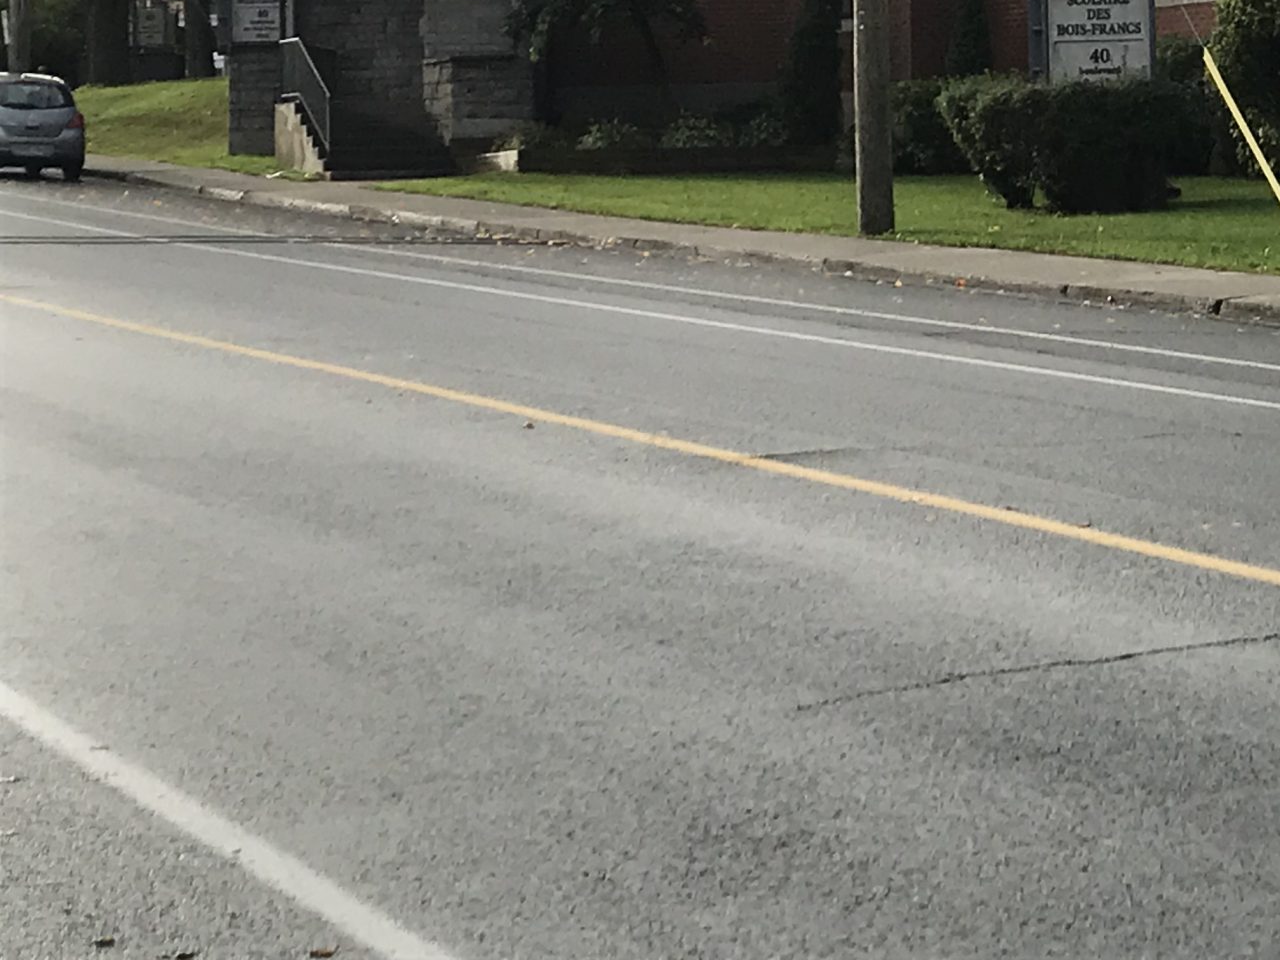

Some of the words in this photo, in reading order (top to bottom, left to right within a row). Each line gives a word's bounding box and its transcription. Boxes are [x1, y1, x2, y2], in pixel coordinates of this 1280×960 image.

[1086, 8, 1111, 20] DES
[1056, 21, 1142, 36] BOIS-FRANCS
[1089, 48, 1111, 64] 40
